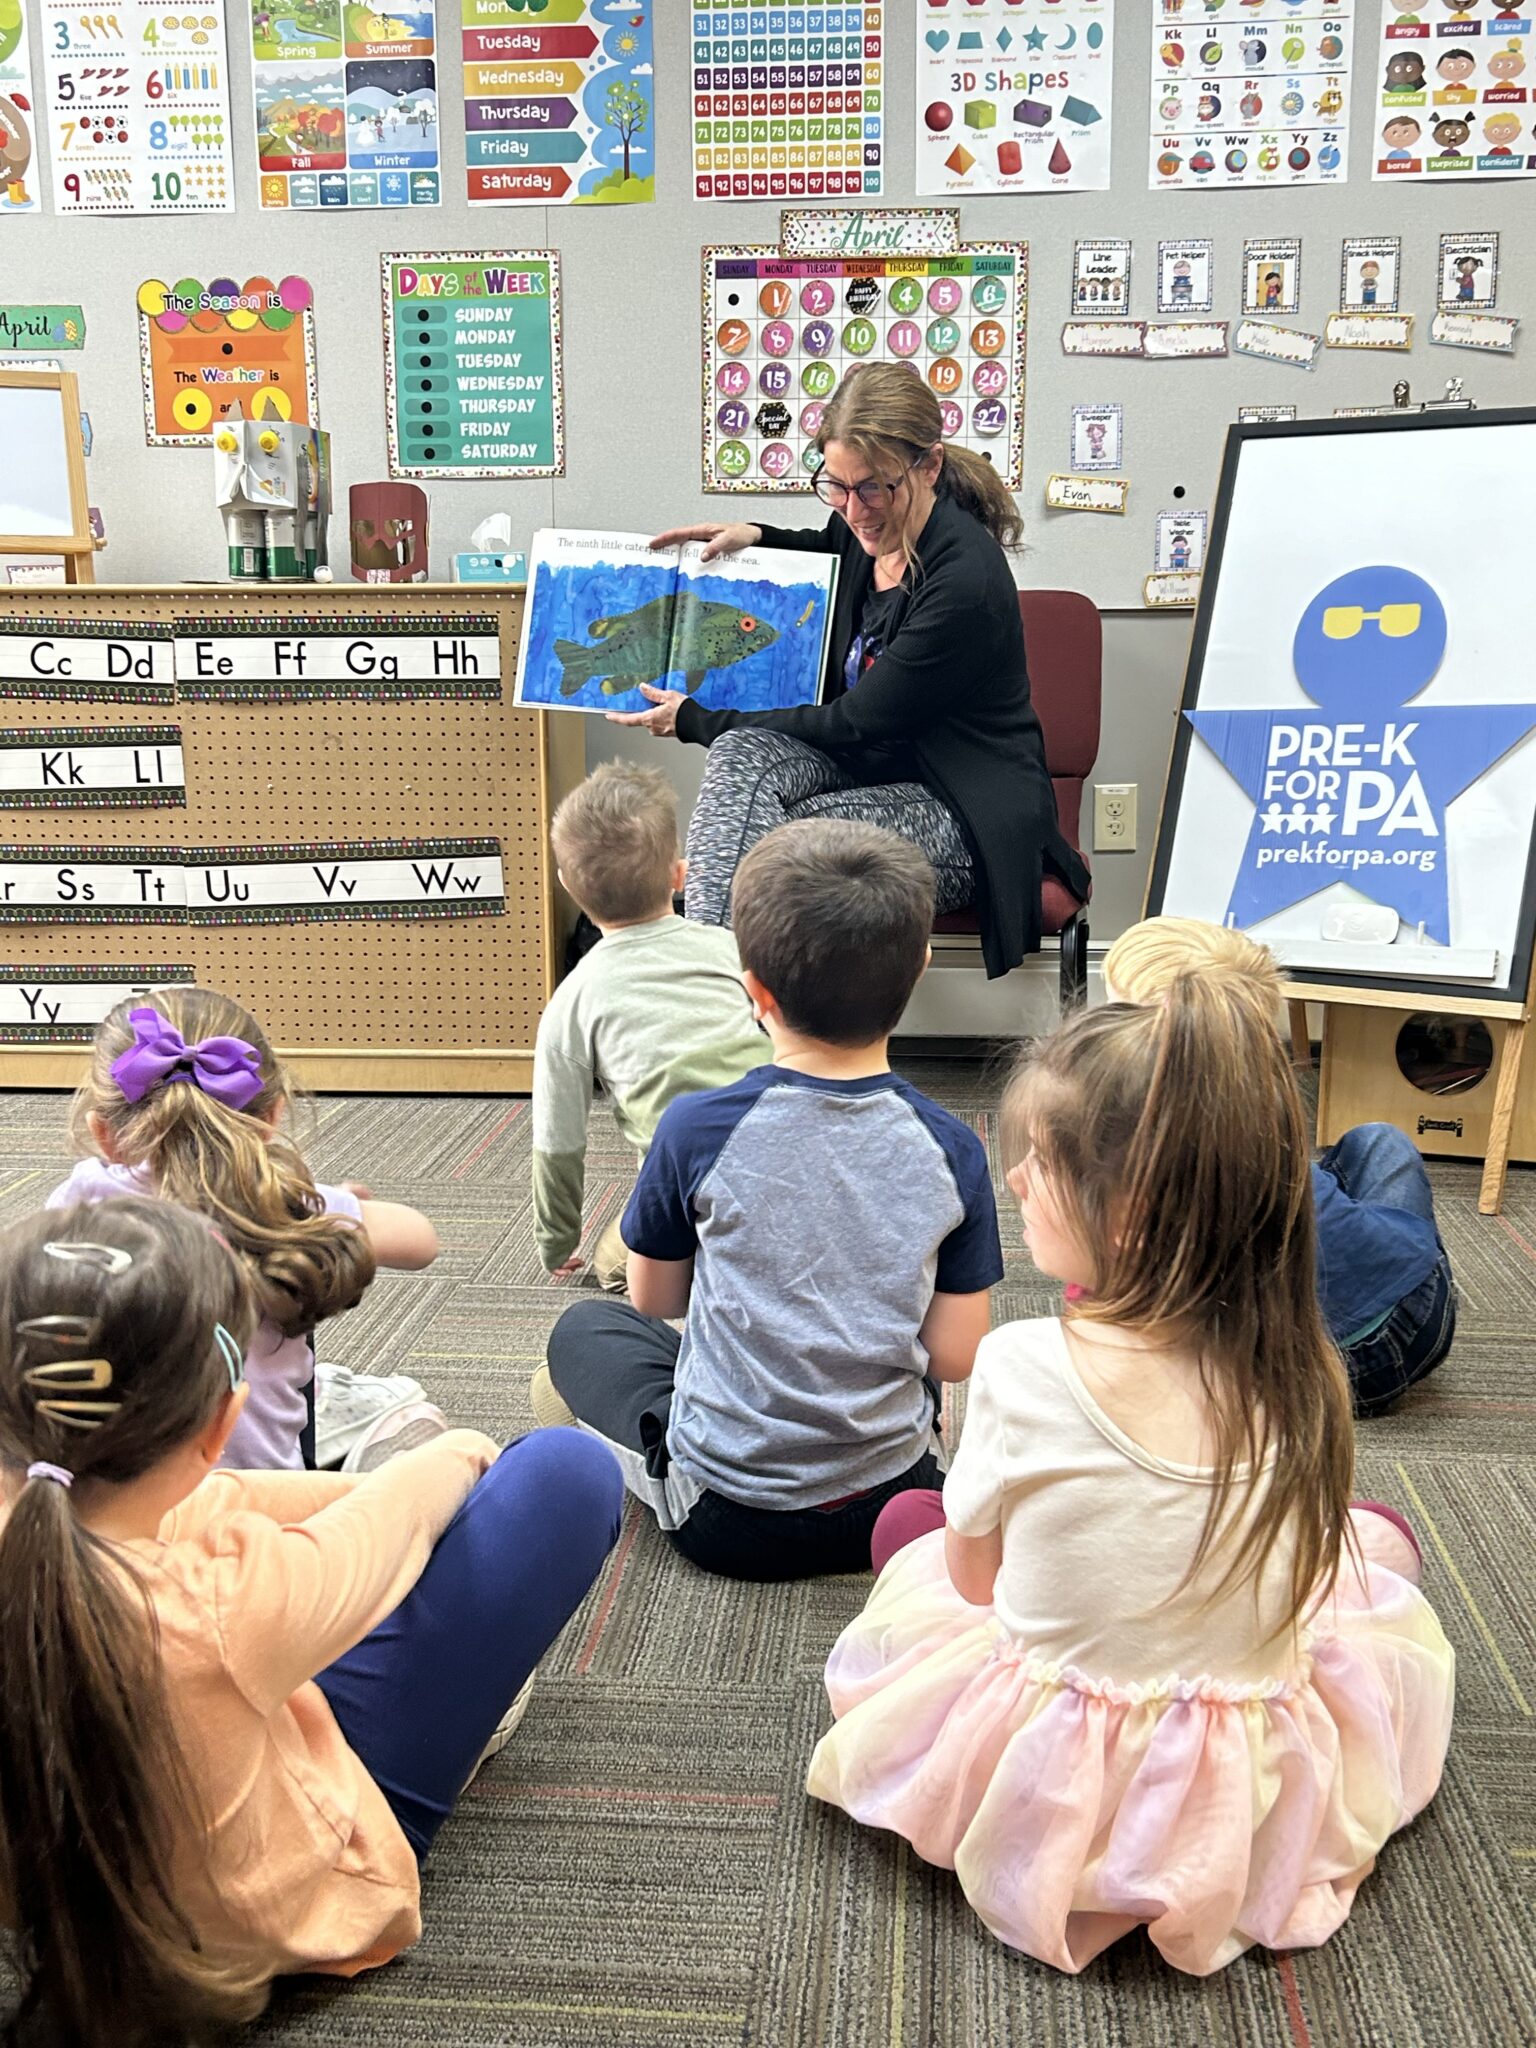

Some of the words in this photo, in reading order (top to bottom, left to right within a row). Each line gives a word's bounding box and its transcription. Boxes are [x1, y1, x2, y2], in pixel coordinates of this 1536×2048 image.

[54, 21, 70, 50] 3
[143, 18, 160, 47] 4
[1165, 29, 1182, 40] Kk
[1206, 28, 1217, 38] Ll
[1244, 26, 1268, 36] Mm
[1285, 24, 1302, 34] Nn
[1323, 22, 1341, 32] Oo
[1443, 24, 1474, 33] excited
[1494, 23, 1522, 31] scared
[276, 44, 316, 58] Spring
[365, 42, 413, 55] Summer
[477, 35, 541, 52] Tuesday
[58, 73, 75, 100] 5
[146, 70, 163, 99] 6
[478, 70, 564, 87] Wednesday
[951, 72, 976, 92] 3D
[985, 70, 1069, 95] Shapes
[1163, 84, 1179, 95] Pp
[1201, 82, 1220, 94] Qq
[1244, 80, 1259, 90] Rr
[1286, 79, 1300, 88] Ss
[1326, 77, 1339, 86] Tt
[1384, 94, 1423, 103] confused
[1488, 92, 1520, 101] worried
[479, 105, 550, 122] Thursday
[60, 122, 76, 151] 7
[150, 121, 168, 150] 8
[927, 134, 950, 142] Sphere
[1163, 138, 1179, 148] Uu
[1195, 137, 1212, 147] Vv
[1224, 136, 1249, 145] Ww
[1260, 135, 1278, 144] Xx
[1291, 133, 1309, 145] Yy
[1322, 132, 1338, 142] Zz
[480, 140, 529, 157] Friday
[291, 157, 311, 168] Fall
[374, 155, 411, 166] Winter
[1387, 162, 1411, 170] bored
[1430, 160, 1470, 169] surprised
[1480, 158, 1519, 167] confident
[64, 174, 80, 202] 9
[152, 172, 181, 200] 10
[481, 174, 551, 191] Saturday
[699, 183, 709, 192] 91
[716, 181, 728, 192] 92
[735, 181, 747, 190] 93
[753, 180, 766, 190] 94
[772, 180, 784, 189] 95
[790, 179, 803, 189] 96
[809, 178, 822, 188] 97
[828, 178, 841, 188] 98
[847, 177, 860, 187] 99
[866, 178, 879, 187] 100
[830, 211, 904, 254] April
[1445, 246, 1492, 255] Electrician
[722, 266, 750, 275] SUNDAY
[764, 264, 794, 274] MONDAY
[806, 263, 838, 274] TUESDAY
[845, 264, 881, 274] WEDNESDAY
[889, 262, 926, 273] THURSDAY
[938, 262, 964, 273] FRIDAY
[975, 262, 1011, 273] SATURDAY
[1086, 264, 1118, 275] Leader
[464, 272, 478, 283] of
[463, 285, 482, 296] the
[772, 288, 782, 307] 1
[813, 290, 827, 309] 2
[899, 287, 914, 306] 4
[939, 287, 952, 305] 5
[983, 283, 996, 303] 6
[161, 294, 194, 311] The
[199, 293, 260, 311] Season
[266, 293, 282, 309] is
[454, 307, 513, 323] SUNDAY
[0, 312, 52, 348] April
[454, 329, 516, 345] MONDAY
[727, 328, 742, 347] 7
[770, 330, 785, 349] 8
[811, 328, 825, 347] 9
[850, 328, 870, 345] 10
[898, 329, 912, 347] 11
[934, 326, 954, 345] 12
[979, 329, 999, 348] 13
[455, 353, 522, 369] TUESDAY
[174, 371, 197, 384] The
[201, 367, 265, 384] Weather
[269, 370, 280, 382] is
[456, 375, 544, 391] WEDNESDAY
[723, 371, 743, 388] 14
[765, 371, 785, 389] 15
[810, 370, 828, 388] 16
[936, 366, 954, 384] 19
[978, 370, 1002, 388] 20
[459, 398, 536, 414] THURSDAY
[723, 409, 742, 428] 21
[978, 406, 1001, 426] 27
[940, 409, 958, 428] 6
[459, 422, 511, 437] FRIDAY
[460, 443, 538, 459] SATURDAY
[722, 449, 745, 467] 28
[764, 452, 789, 468] 29
[1063, 485, 1092, 501] Evan
[557, 537, 574, 547] The
[576, 539, 599, 549] ninth
[601, 540, 622, 550] little
[684, 548, 699, 558] fell
[722, 553, 739, 563] the
[741, 557, 760, 565] sea.
[30, 641, 72, 676] Cc
[107, 644, 154, 679] Dd
[197, 641, 234, 676] Ee
[274, 641, 307, 675] Ff
[345, 641, 398, 680] Gg
[434, 641, 479, 675] Hh
[1267, 723, 1420, 767] PRE-K
[41, 752, 85, 786] Kk
[134, 750, 164, 784] Ll
[1263, 769, 1342, 800] FOR
[1341, 769, 1440, 836] PA
[1256, 841, 1436, 872] prekforpa.org
[56, 868, 95, 901] Ss
[133, 868, 165, 902] Tt
[205, 869, 250, 903] Uu
[312, 865, 358, 898] Vv
[411, 861, 482, 894] Ww
[20, 988, 62, 1024] Yy
